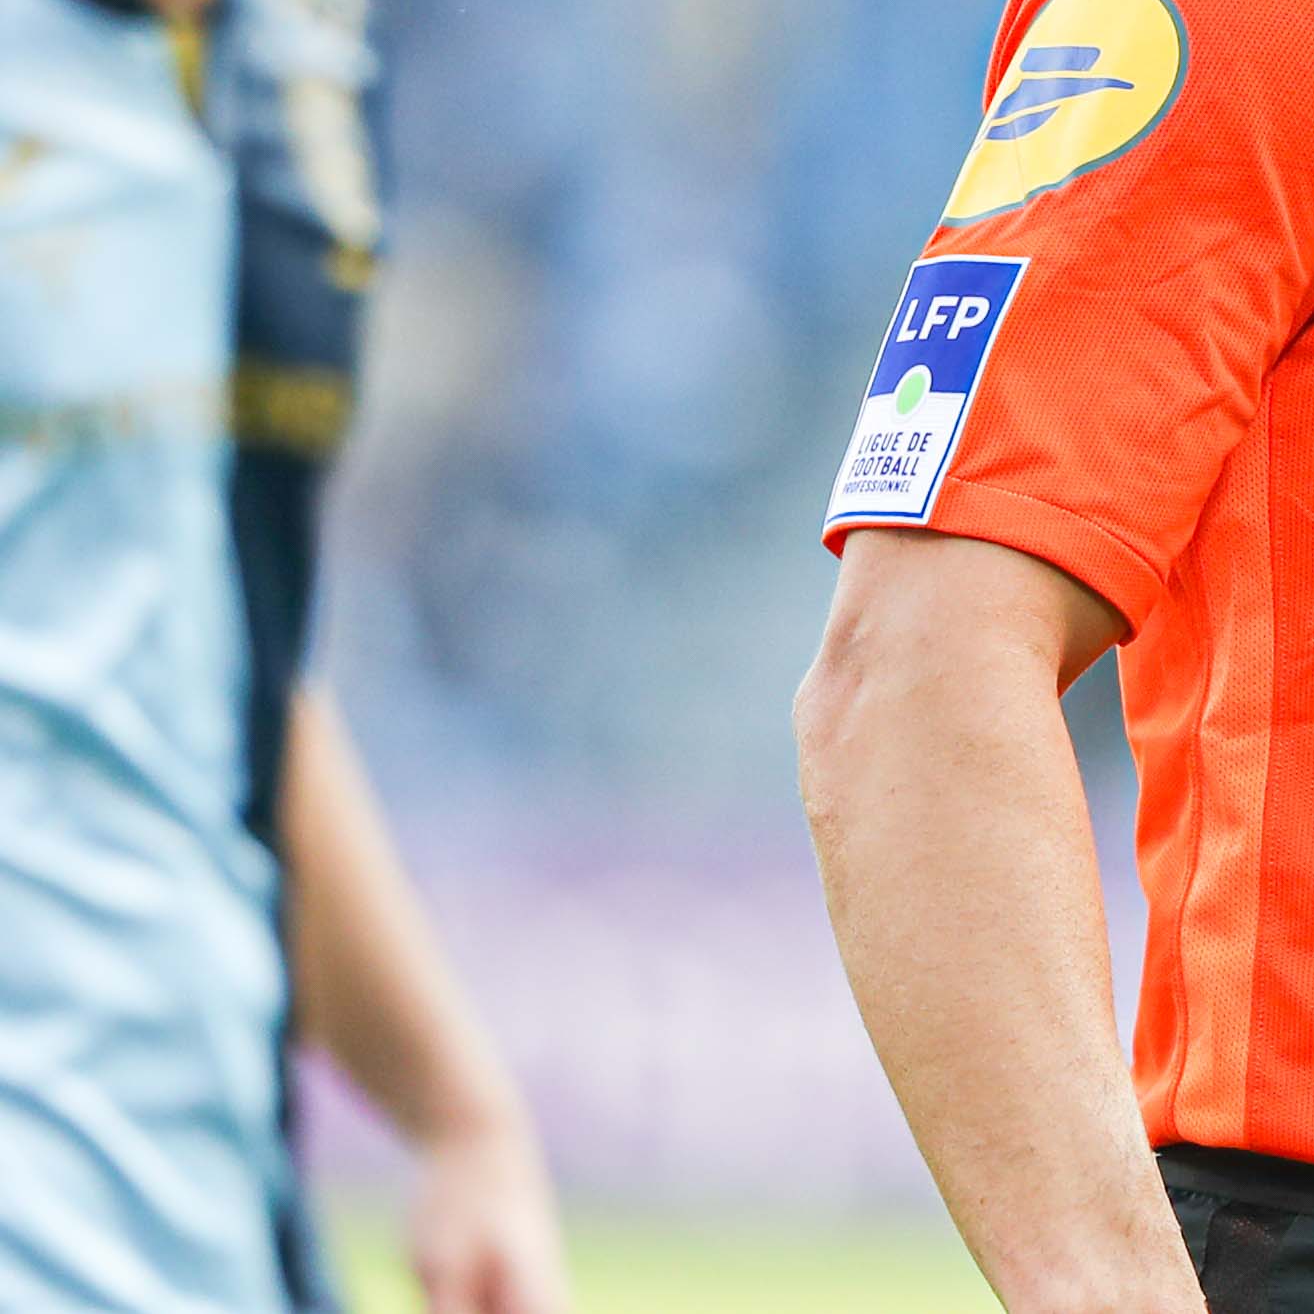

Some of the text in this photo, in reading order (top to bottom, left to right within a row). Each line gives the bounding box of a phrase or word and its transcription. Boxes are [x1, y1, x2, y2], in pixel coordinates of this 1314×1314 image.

[896, 295, 991, 343] LFP
[858, 432, 933, 455] LIGUE DE
[847, 456, 920, 480] FOOTBALL
